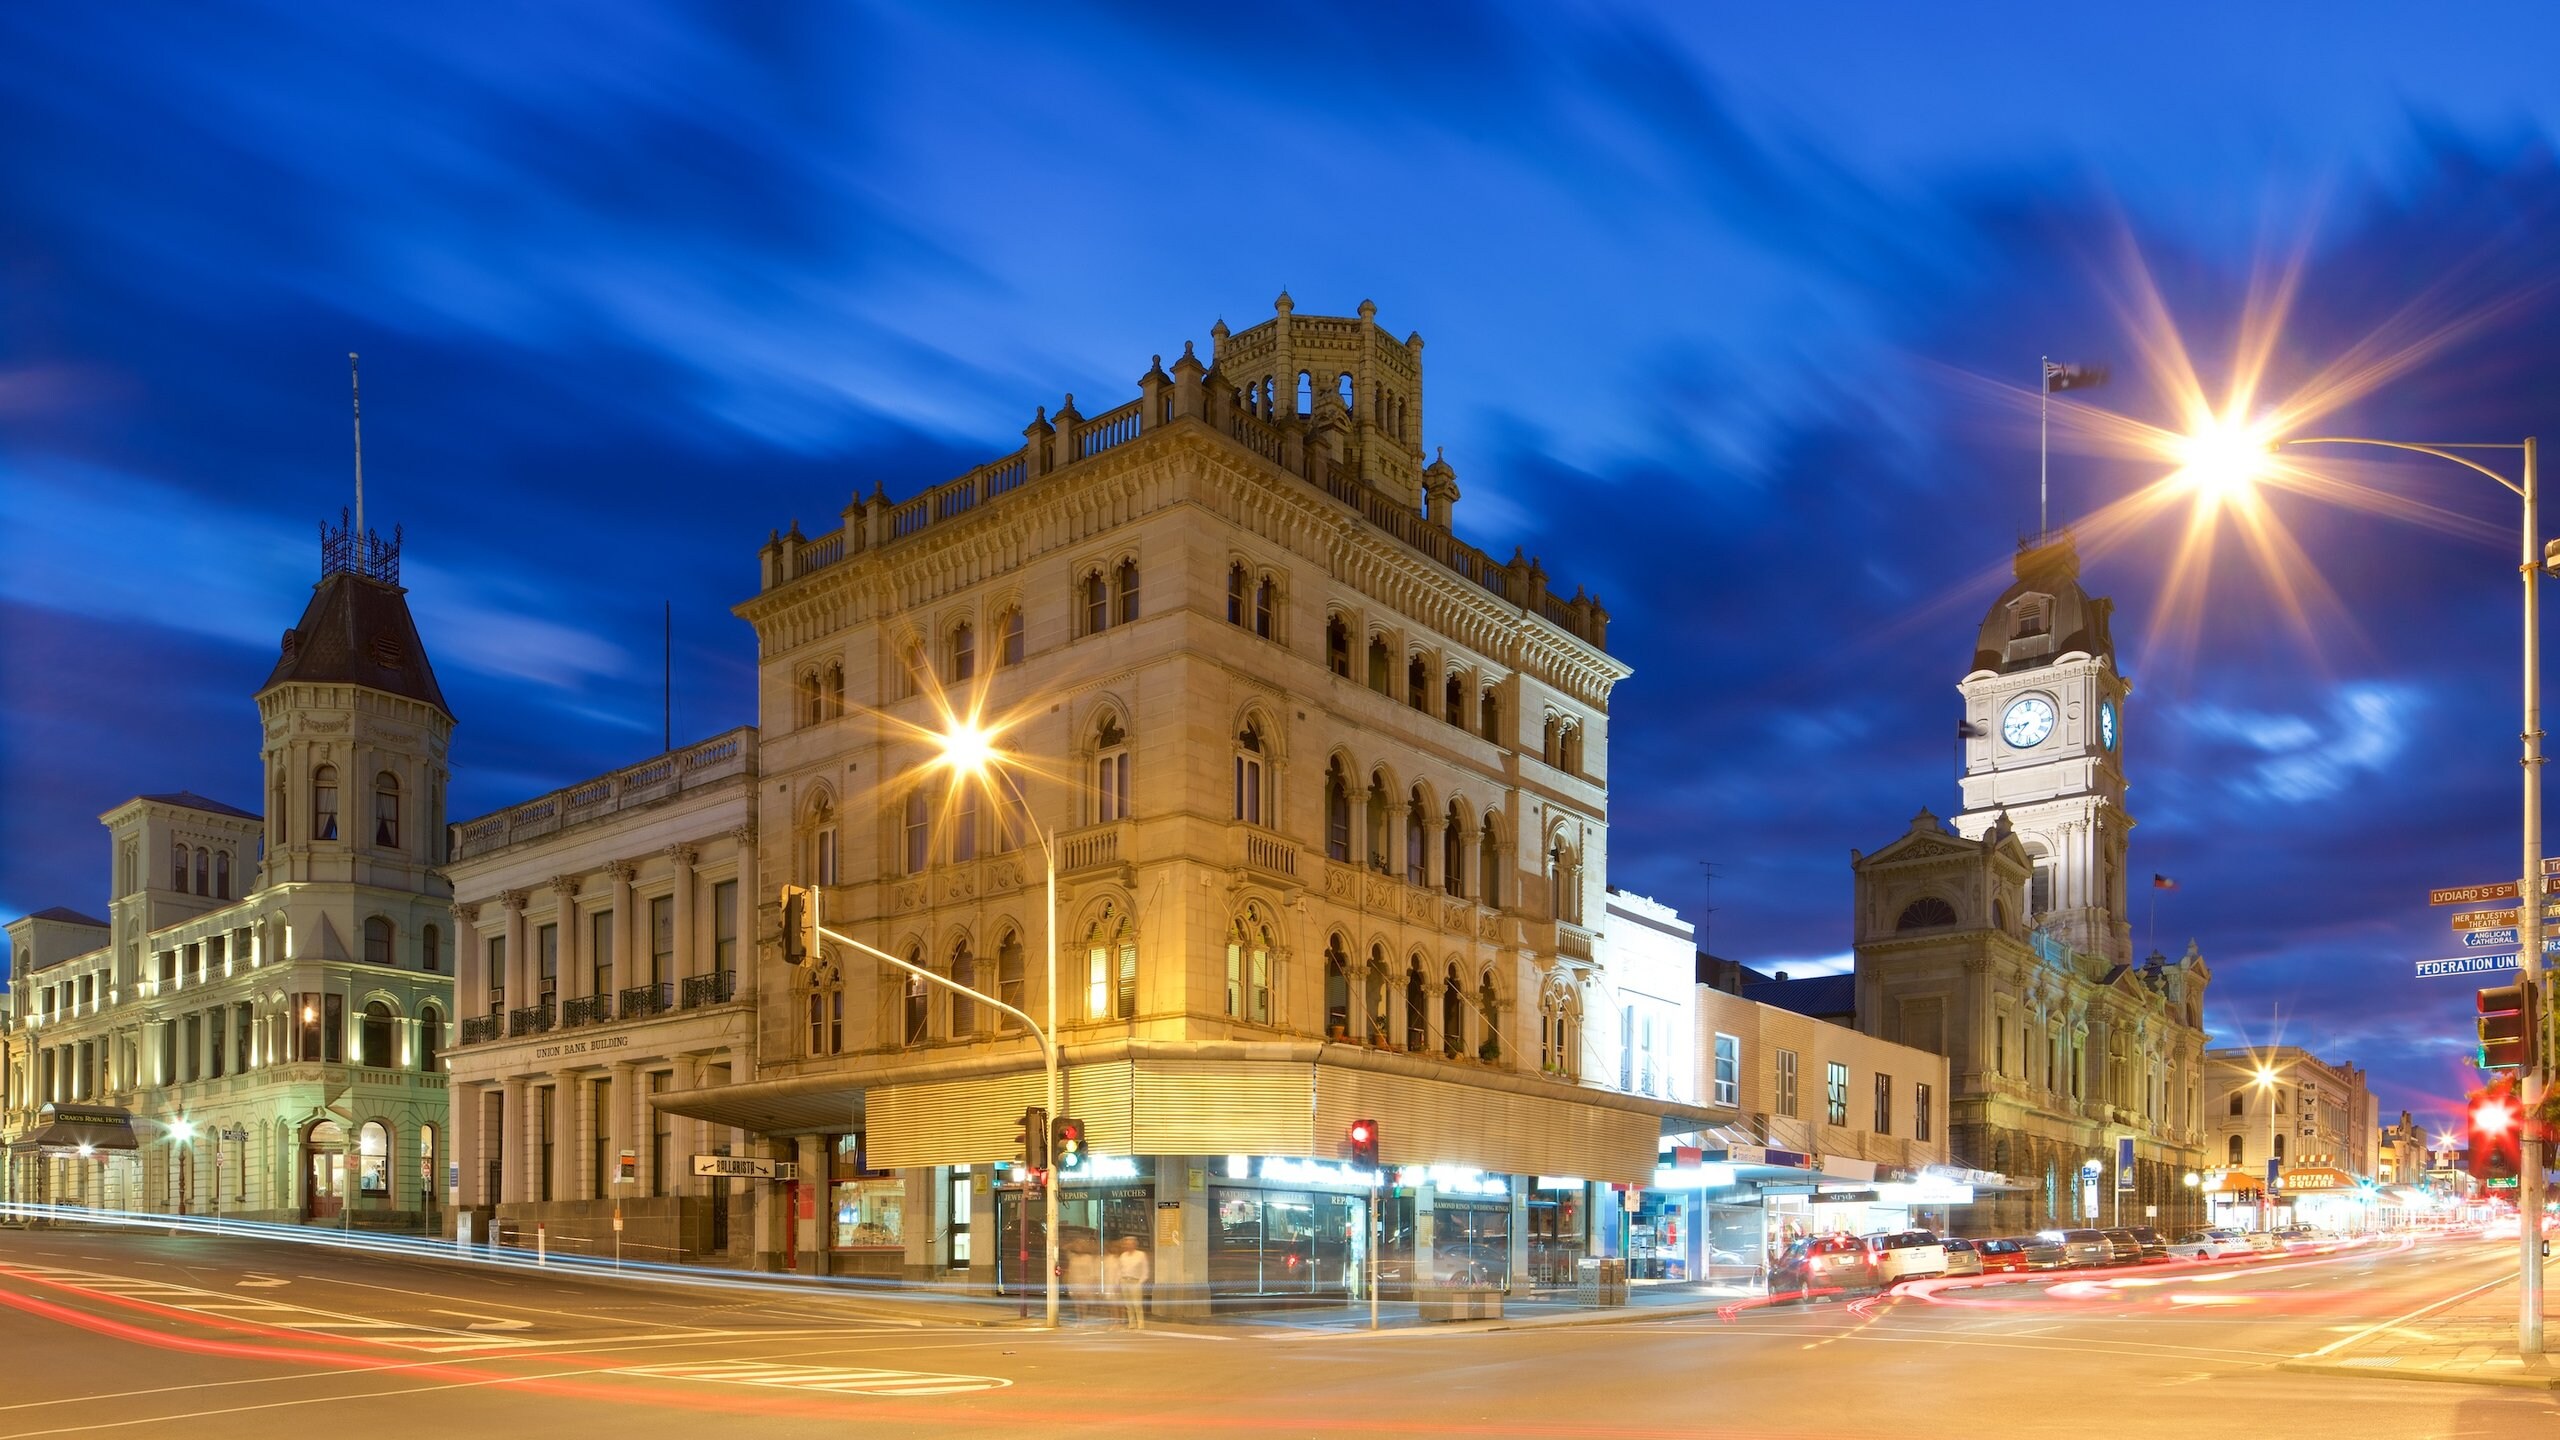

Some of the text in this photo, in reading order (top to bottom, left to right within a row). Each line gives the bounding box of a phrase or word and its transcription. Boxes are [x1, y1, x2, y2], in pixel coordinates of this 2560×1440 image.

[2433, 889, 2478, 903] LYDIARD
[2455, 910, 2515, 923] HER MAJESTY'S
[2469, 919, 2501, 928] THEATRE
[2474, 930, 2512, 939] ANGLICAN
[2471, 937, 2514, 946] CATHEDRAL
[2417, 958, 2493, 976] FEDERATION
[536, 1036, 628, 1058] UNION BANK BUILDING
[2304, 1083, 2316, 1136] MYER
[105, 1116, 126, 1124] HOTEL
[716, 1160, 755, 1175] BALLARISTA
[2289, 1174, 2335, 1182] CENTRAL
[2288, 1180, 2335, 1188] SQUARE
[1111, 1189, 1147, 1197] WATCHES
[1219, 1190, 1251, 1198] WATCHES
[1830, 1192, 1856, 1202] stryde
